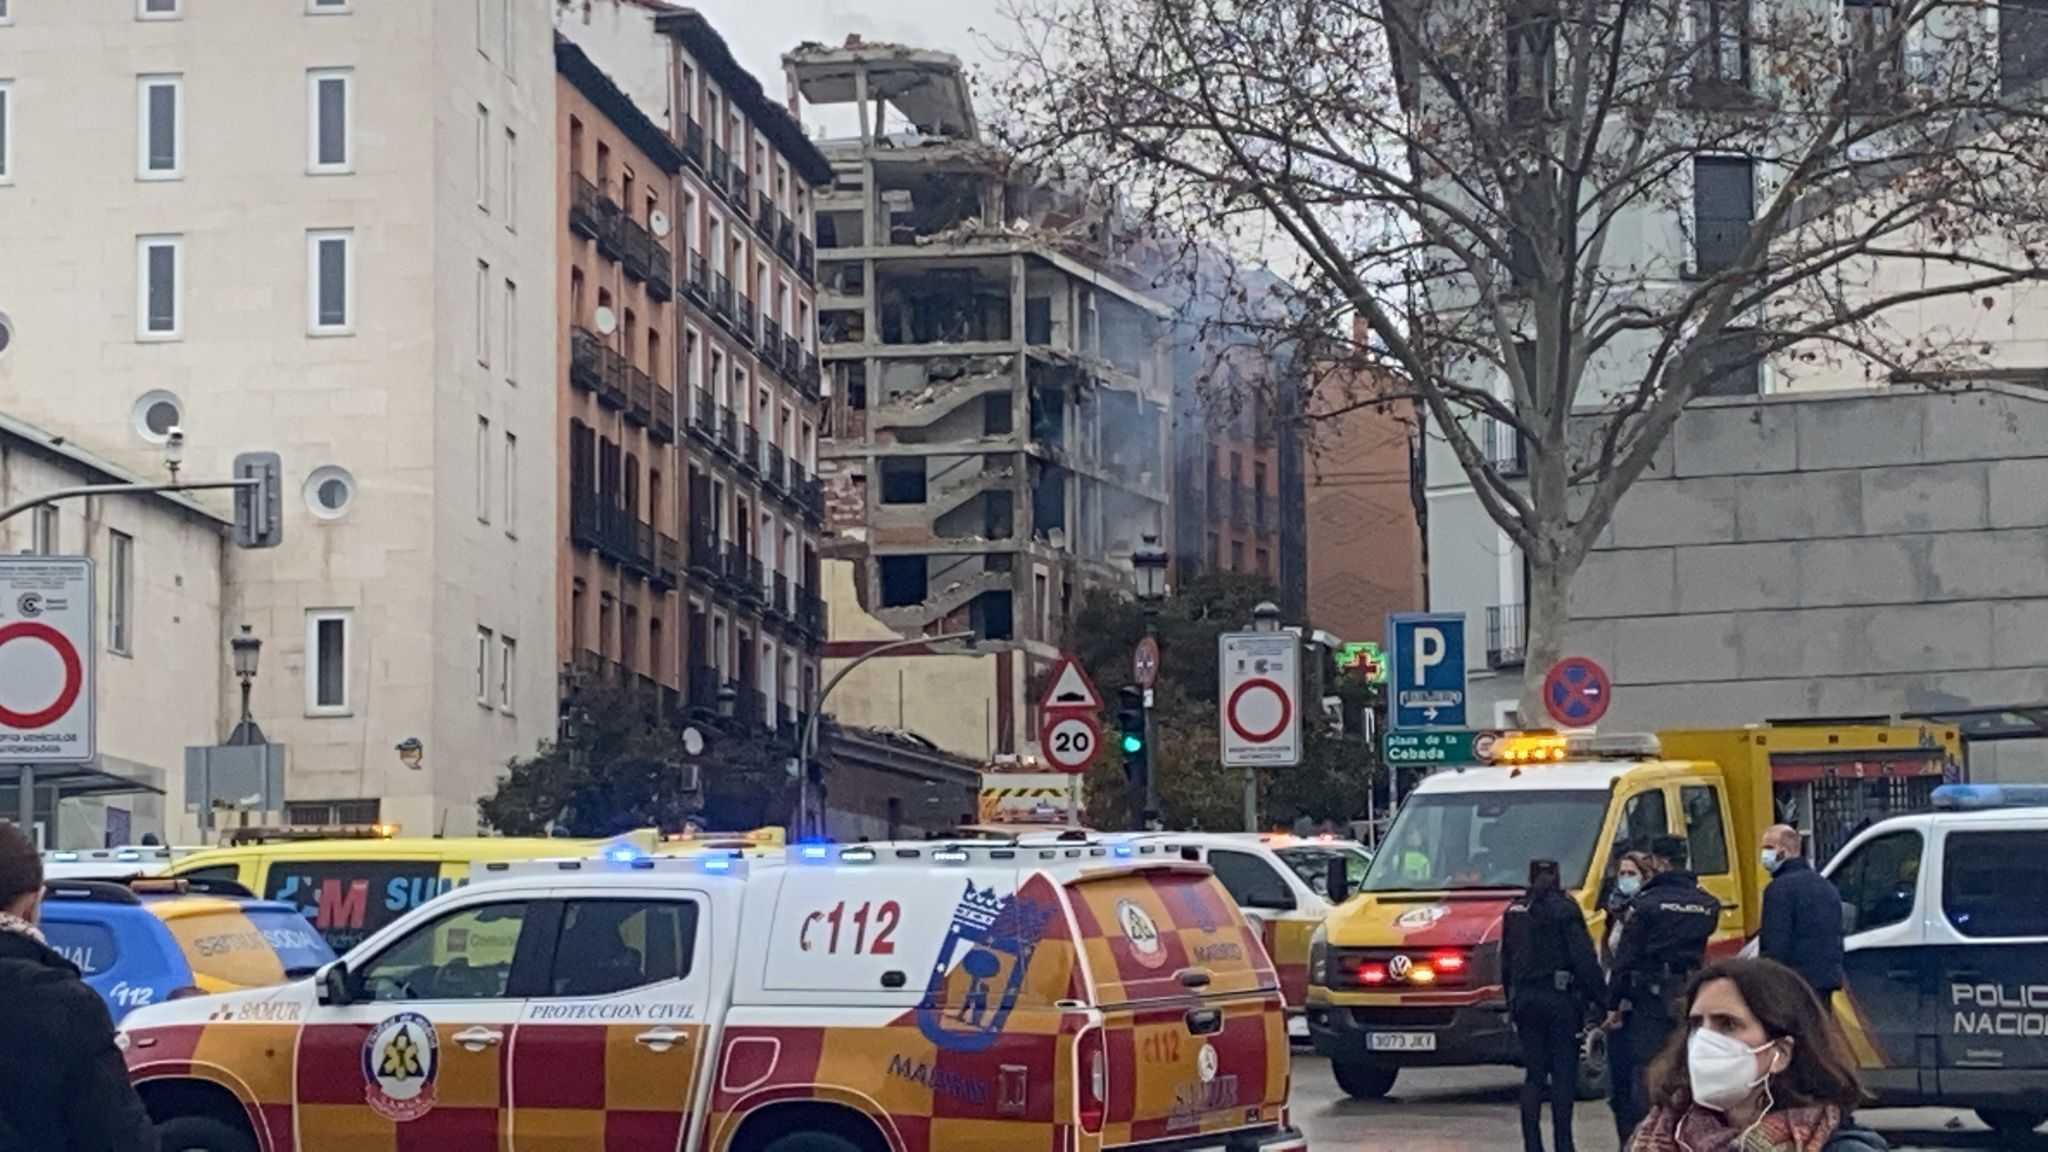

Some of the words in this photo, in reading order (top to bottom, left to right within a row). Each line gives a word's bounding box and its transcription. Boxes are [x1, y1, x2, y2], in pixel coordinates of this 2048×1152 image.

[1414, 627, 1446, 686] P
[1055, 732, 1089, 752] 20
[1389, 747, 1445, 760] Cebada
[827, 900, 900, 955] 112
[118, 986, 154, 1006] 112
[529, 1003, 645, 1019] PROTECCION
[648, 1003, 696, 1019] CIVIL
[1953, 1011, 2048, 1037] NACIO
